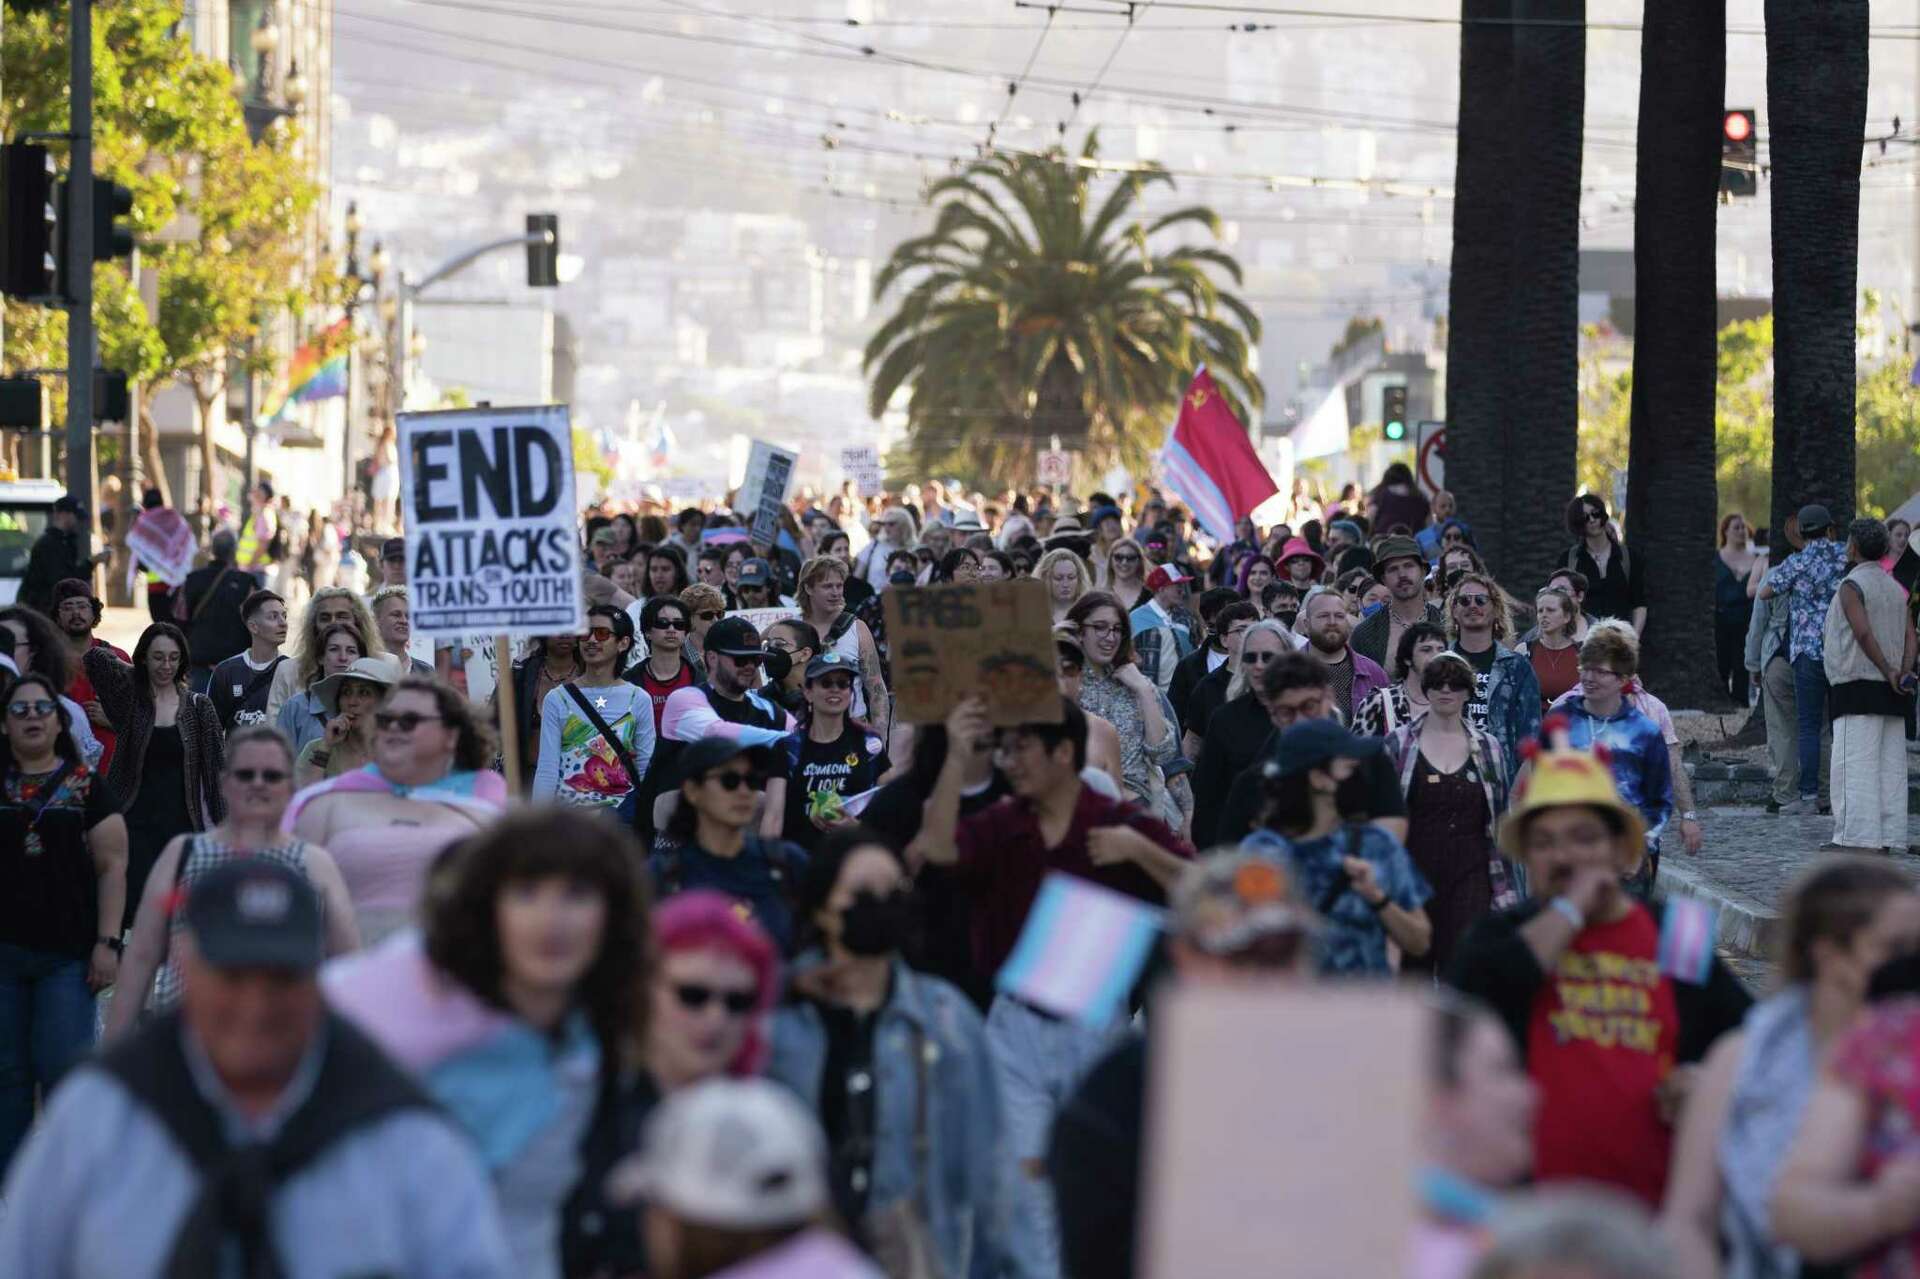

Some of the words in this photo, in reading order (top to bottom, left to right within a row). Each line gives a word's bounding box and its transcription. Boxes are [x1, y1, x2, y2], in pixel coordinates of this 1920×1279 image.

[410, 426, 563, 524] END
[414, 528, 572, 579] ATTACKS
[414, 578, 489, 609] TRANS
[501, 577, 573, 605] YOUTH!
